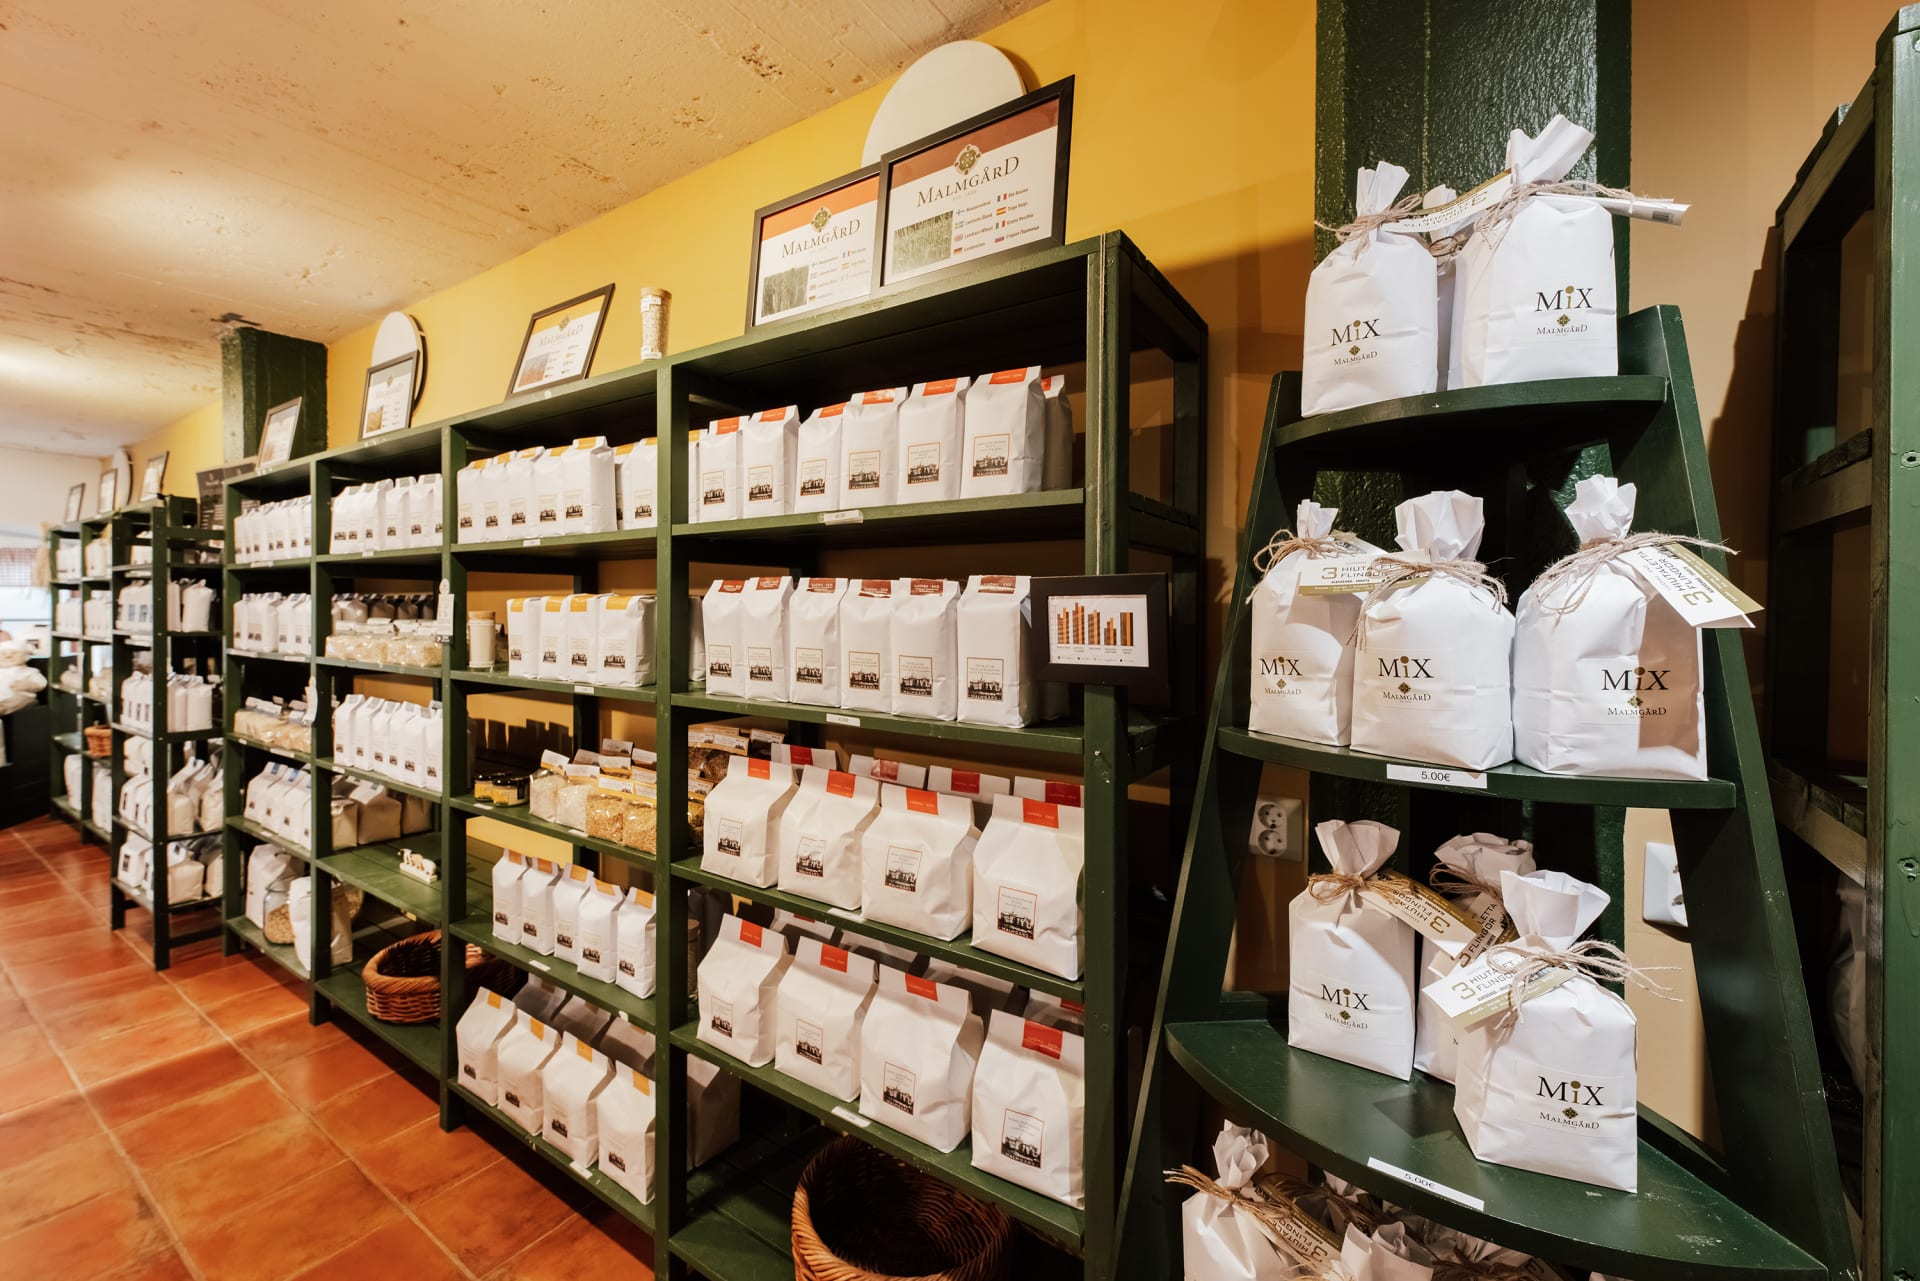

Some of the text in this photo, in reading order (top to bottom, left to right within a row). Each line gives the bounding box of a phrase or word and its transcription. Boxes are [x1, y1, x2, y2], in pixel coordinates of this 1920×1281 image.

[917, 156, 1019, 207] MALMGÅRD
[782, 219, 861, 258] MALMGÅRD
[1321, 567, 1338, 580] 3
[1659, 558, 1697, 590] FLINGOR
[1683, 591, 1713, 606] 3
[1607, 707, 1667, 716] MALMGÅRD
[1421, 770, 1451, 781] 5.00€
[1429, 916, 1450, 934] 3
[1468, 918, 1496, 953] FLINGOR
[1451, 981, 1476, 1000] 3
[1540, 1111, 1600, 1129] MALMGÅRD
[1404, 1173, 1436, 1189] 5.00€
[1311, 1244, 1328, 1263] 3
